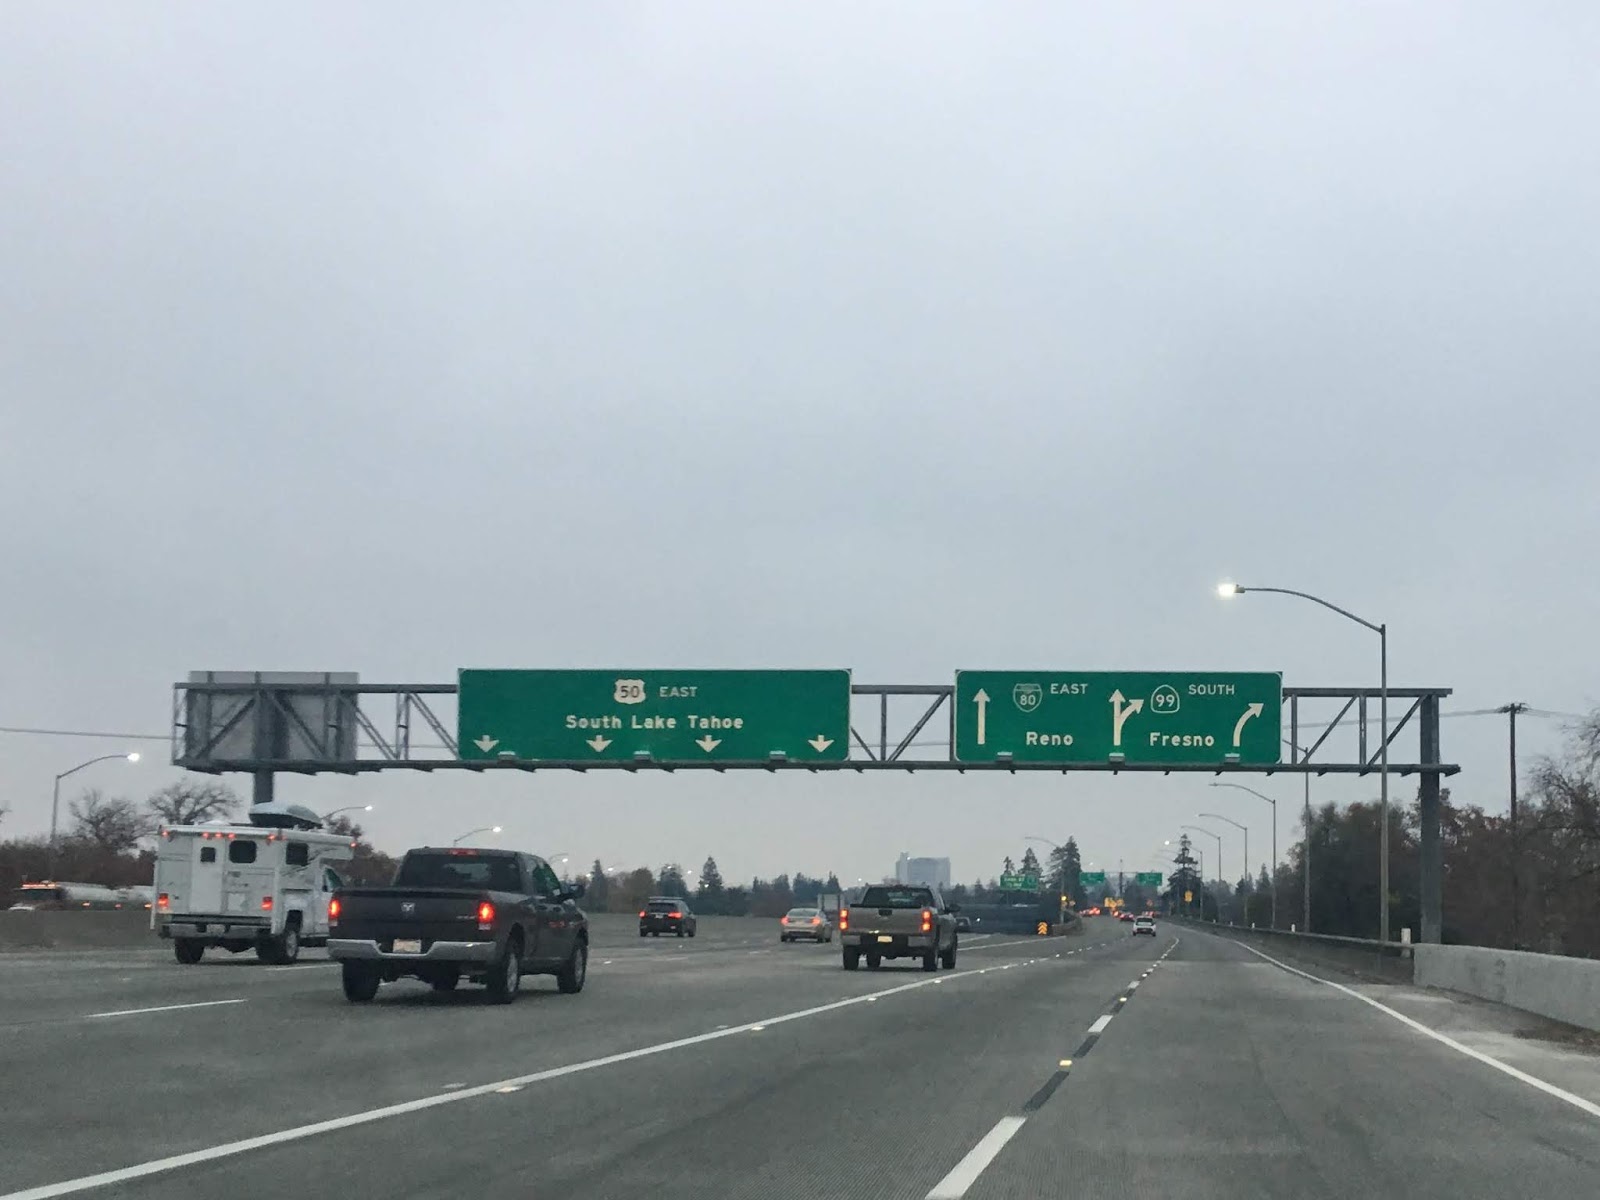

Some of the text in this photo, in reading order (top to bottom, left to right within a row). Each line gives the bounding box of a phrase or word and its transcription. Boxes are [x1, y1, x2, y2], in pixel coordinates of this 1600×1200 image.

[620, 686, 698, 699] 50 EAST
[1020, 683, 1088, 706] 80 EAST
[1155, 683, 1235, 707] 99 SOUTH
[565, 714, 744, 729] South Lake Tahoe
[1026, 731, 1074, 746] Reno
[1149, 731, 1215, 747] Fresno
